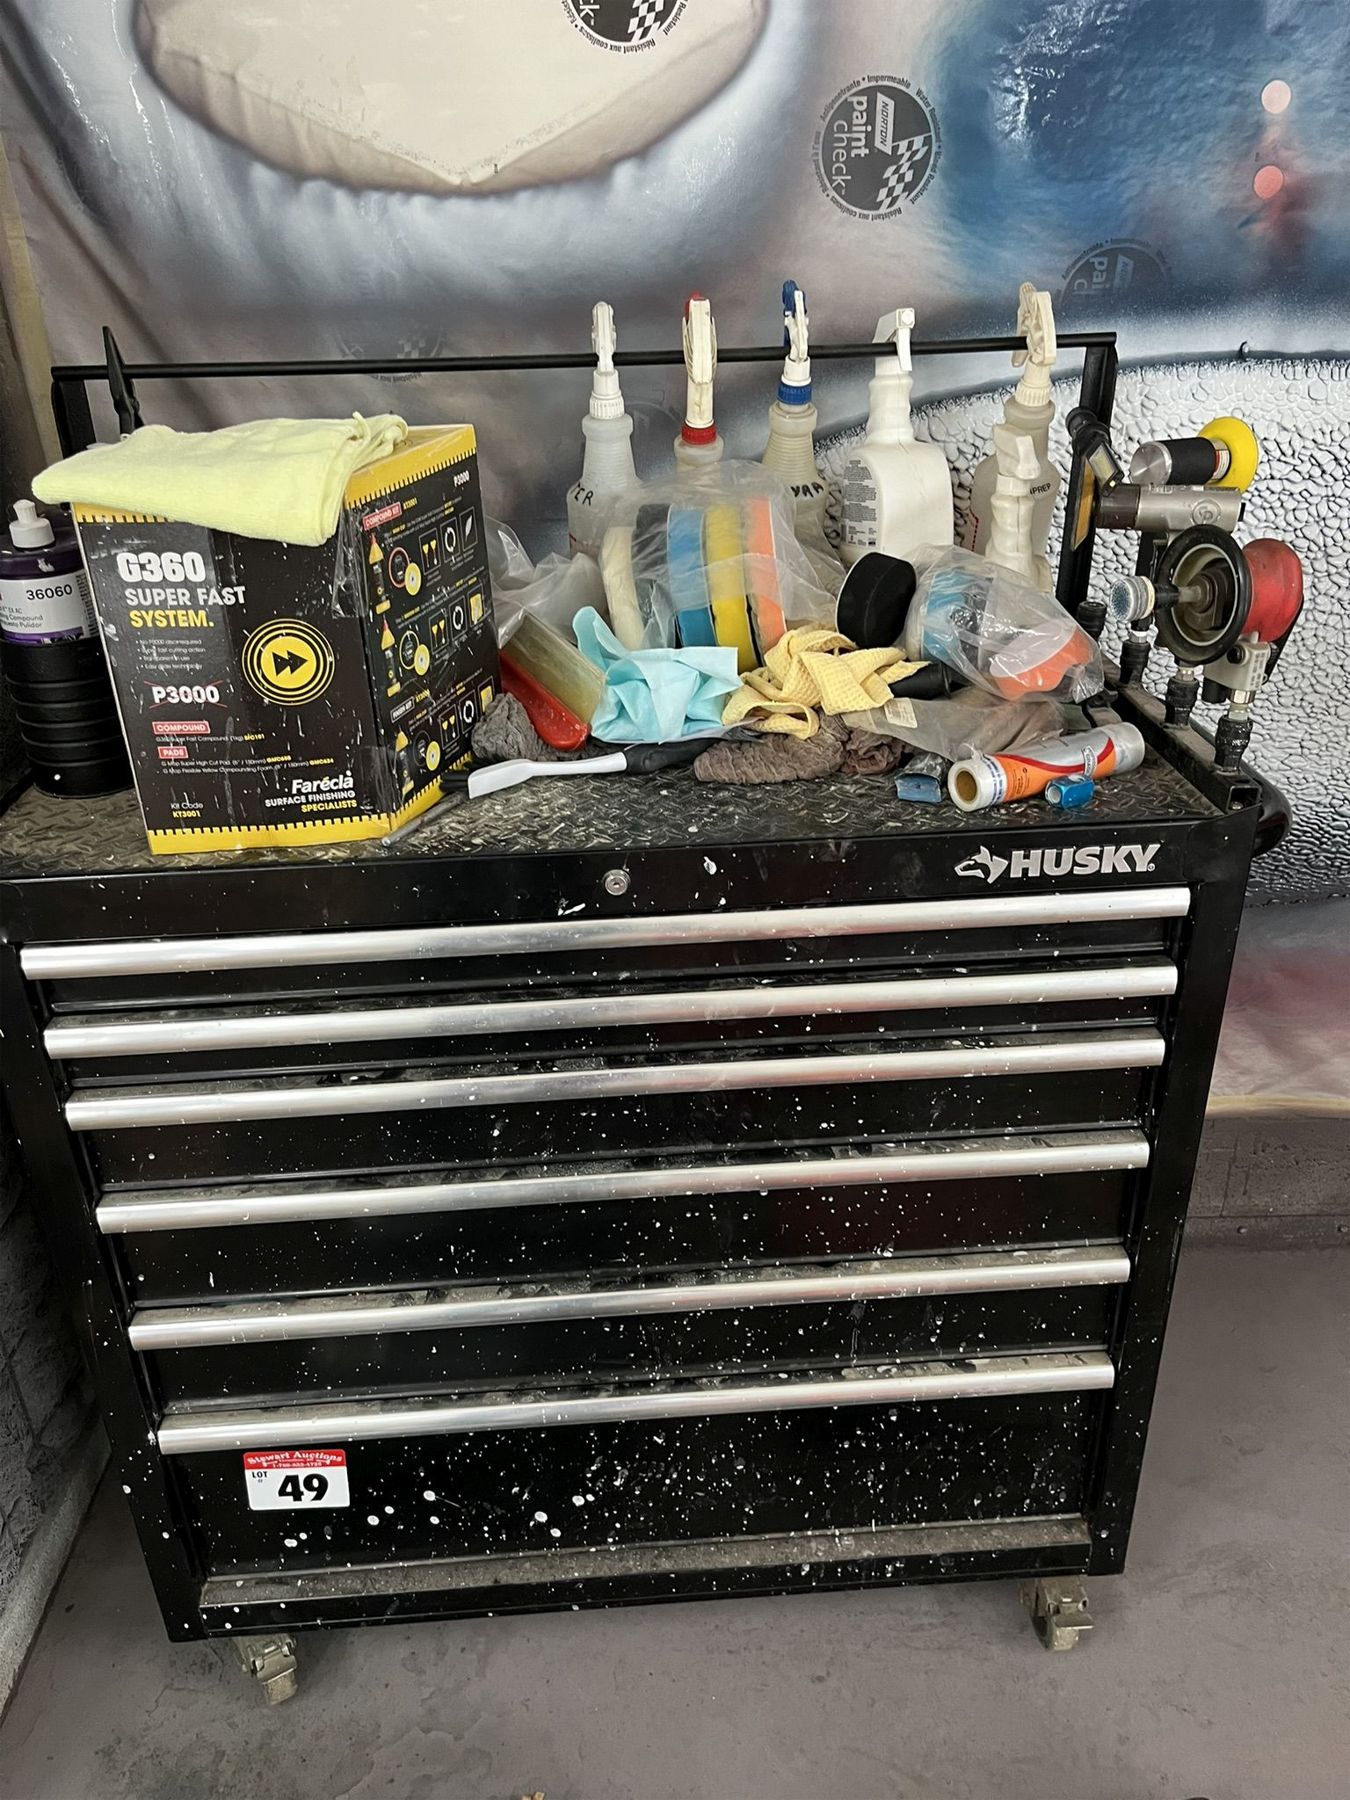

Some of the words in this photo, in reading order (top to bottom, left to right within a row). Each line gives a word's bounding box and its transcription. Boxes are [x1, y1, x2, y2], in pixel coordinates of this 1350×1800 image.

[662, 2, 687, 36] Resistant
[610, 44, 622, 52] aux
[623, 38, 656, 54] Résistant
[847, 95, 872, 158] paint
[880, 101, 889, 147] NORTON
[832, 120, 851, 191] check
[453, 470, 470, 487] P3000
[116, 551, 206, 583] G360
[26, 584, 73, 601] 36060
[125, 588, 192, 607] SUPER
[197, 586, 246, 606] FAST
[130, 610, 214, 628] SYSTEM.
[152, 685, 220, 704] P3000
[157, 724, 206, 732] COMPOUND
[291, 774, 354, 794] Farécla
[265, 795, 306, 807] SURFACE
[308, 790, 356, 803] FINISHING
[301, 799, 357, 813] SPECIALISTS
[247, 1452, 290, 1465] Stewart
[293, 1451, 343, 1462] Auctions
[278, 1473, 329, 1502] 49
